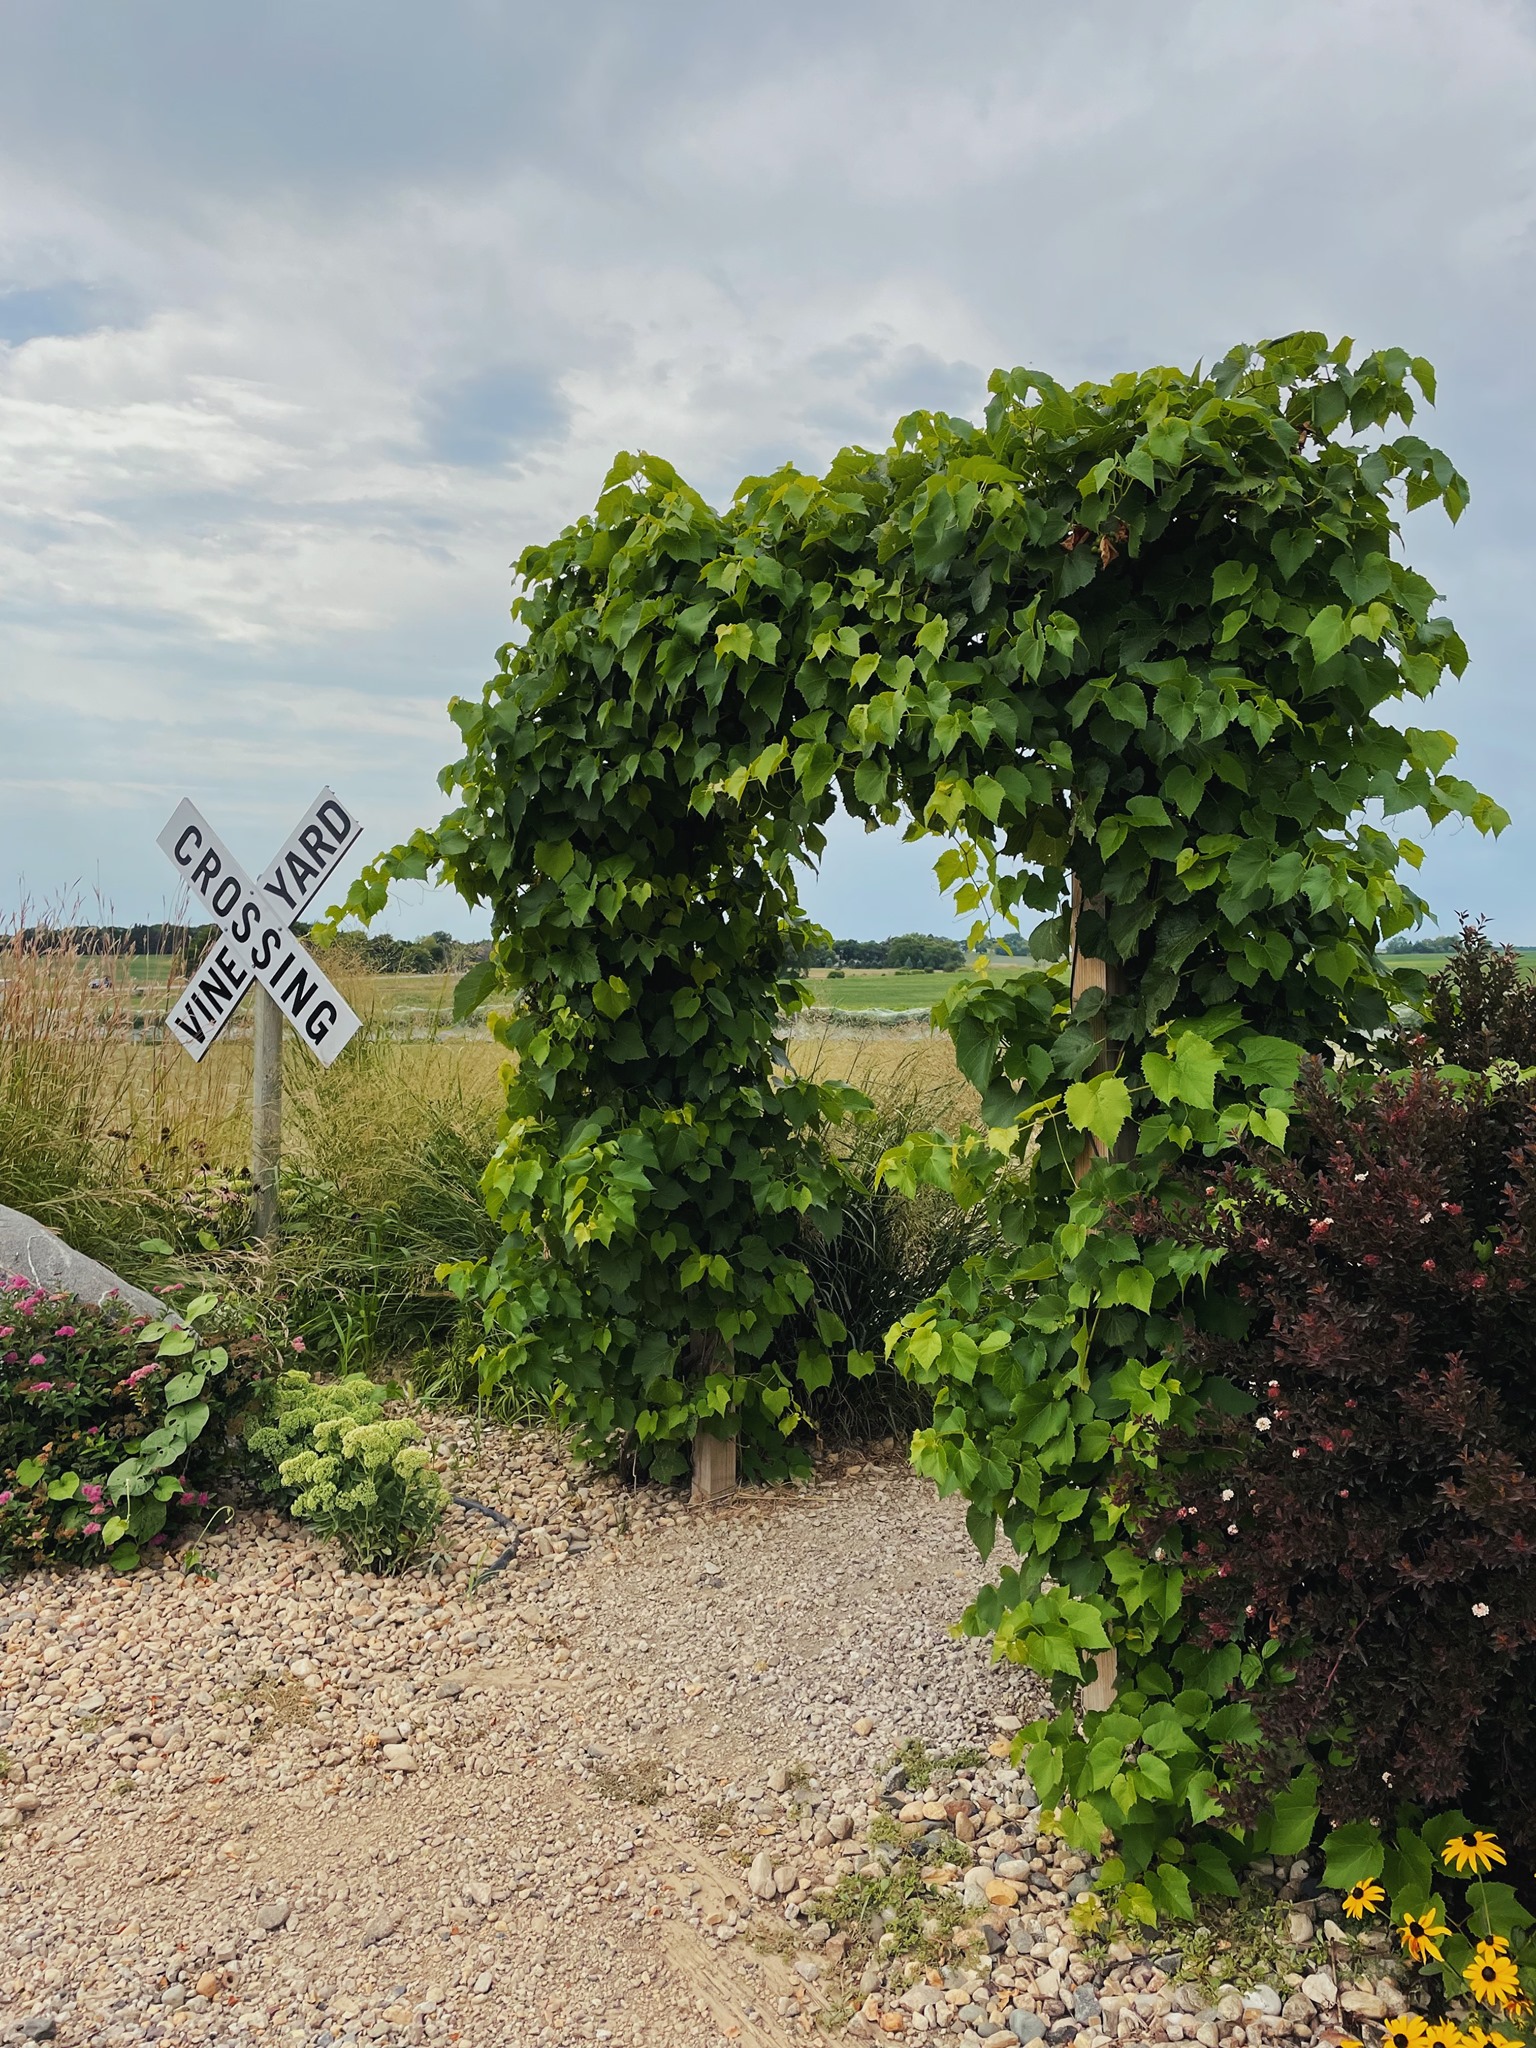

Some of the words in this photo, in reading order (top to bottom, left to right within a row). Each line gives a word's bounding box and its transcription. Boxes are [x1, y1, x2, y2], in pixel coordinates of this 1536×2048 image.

[174, 945, 248, 1044] VINE
[263, 800, 351, 910] YARD
[174, 825, 337, 1046] CROSSING
